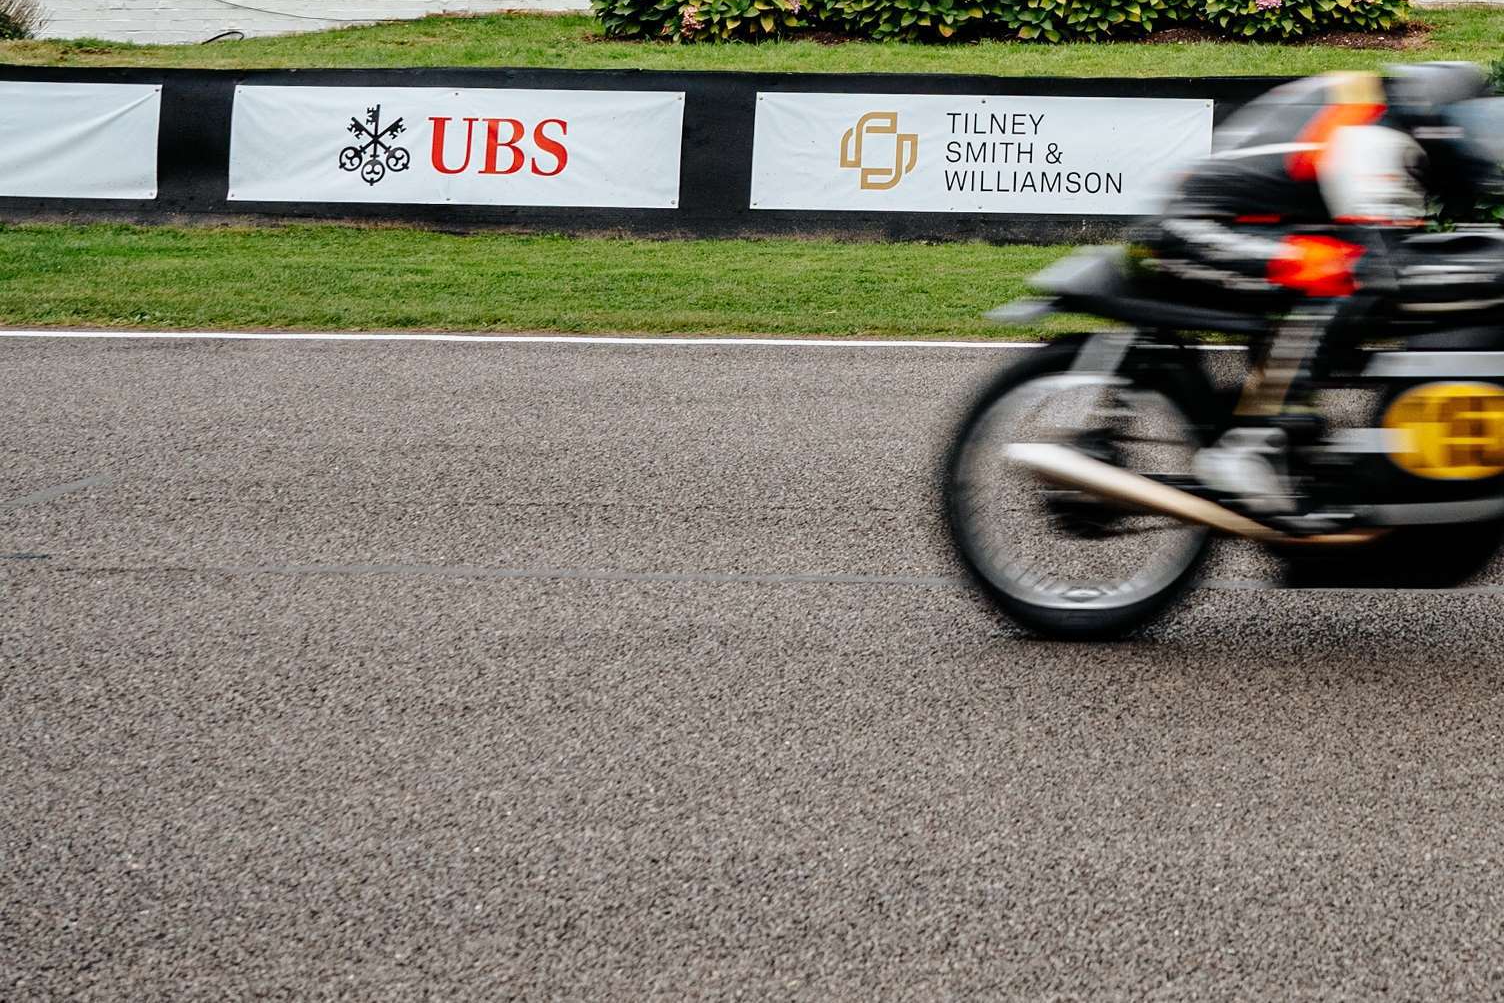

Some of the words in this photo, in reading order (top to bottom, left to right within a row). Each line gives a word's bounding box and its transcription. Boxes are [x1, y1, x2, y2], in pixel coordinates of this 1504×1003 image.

[946, 113, 1045, 135] TILNEY
[428, 116, 568, 176] UBS
[945, 141, 1034, 164] SMITH
[1045, 142, 1063, 165] &
[944, 170, 1122, 194] WILLIAMSON
